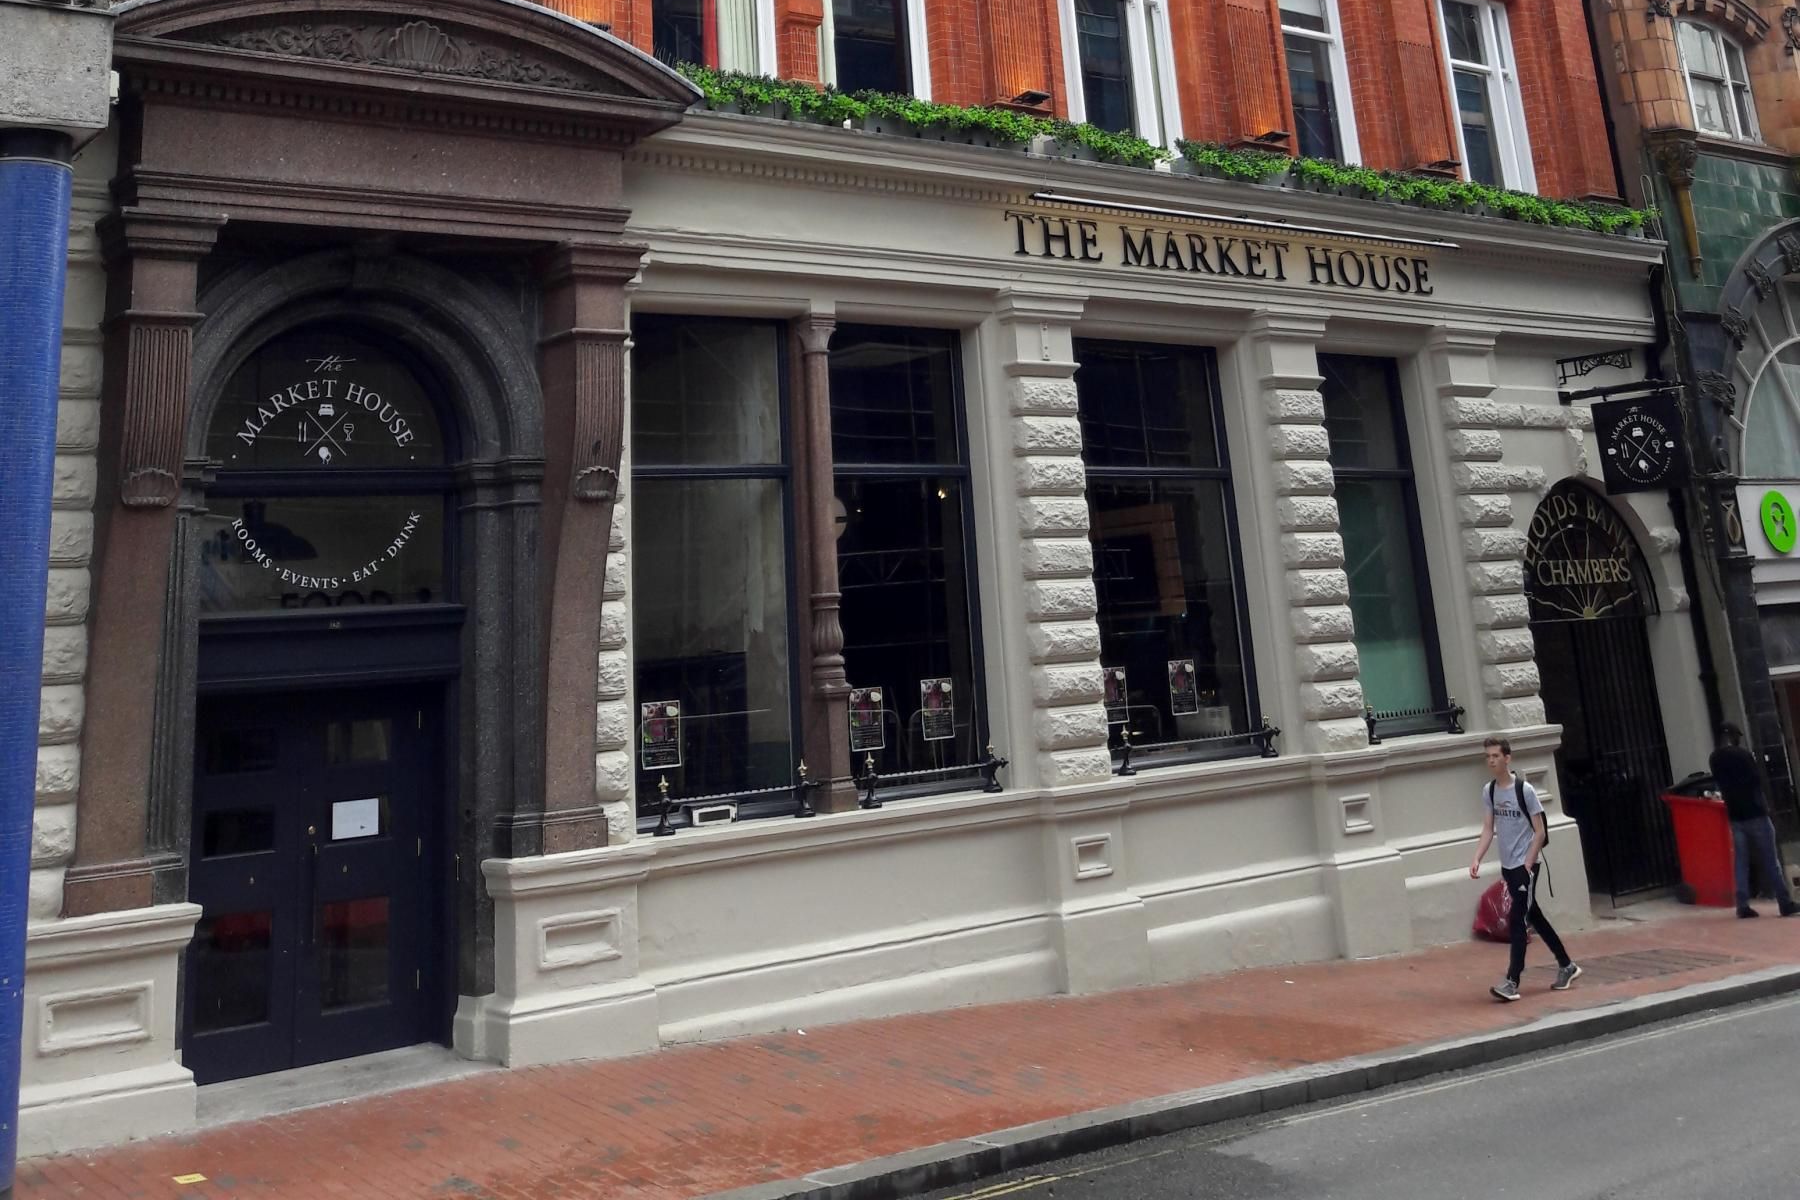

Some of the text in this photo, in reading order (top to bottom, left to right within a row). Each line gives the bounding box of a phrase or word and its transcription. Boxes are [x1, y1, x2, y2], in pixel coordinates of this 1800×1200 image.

[1004, 209, 1434, 295] THE MARKET HOUSE
[237, 379, 415, 447] MARKET HOUSE
[1611, 414, 1666, 441] MARKET HOUSE
[231, 511, 421, 589] ROOMS EVENTS EAT DRINK
[1536, 557, 1632, 587] CHAMBERS
